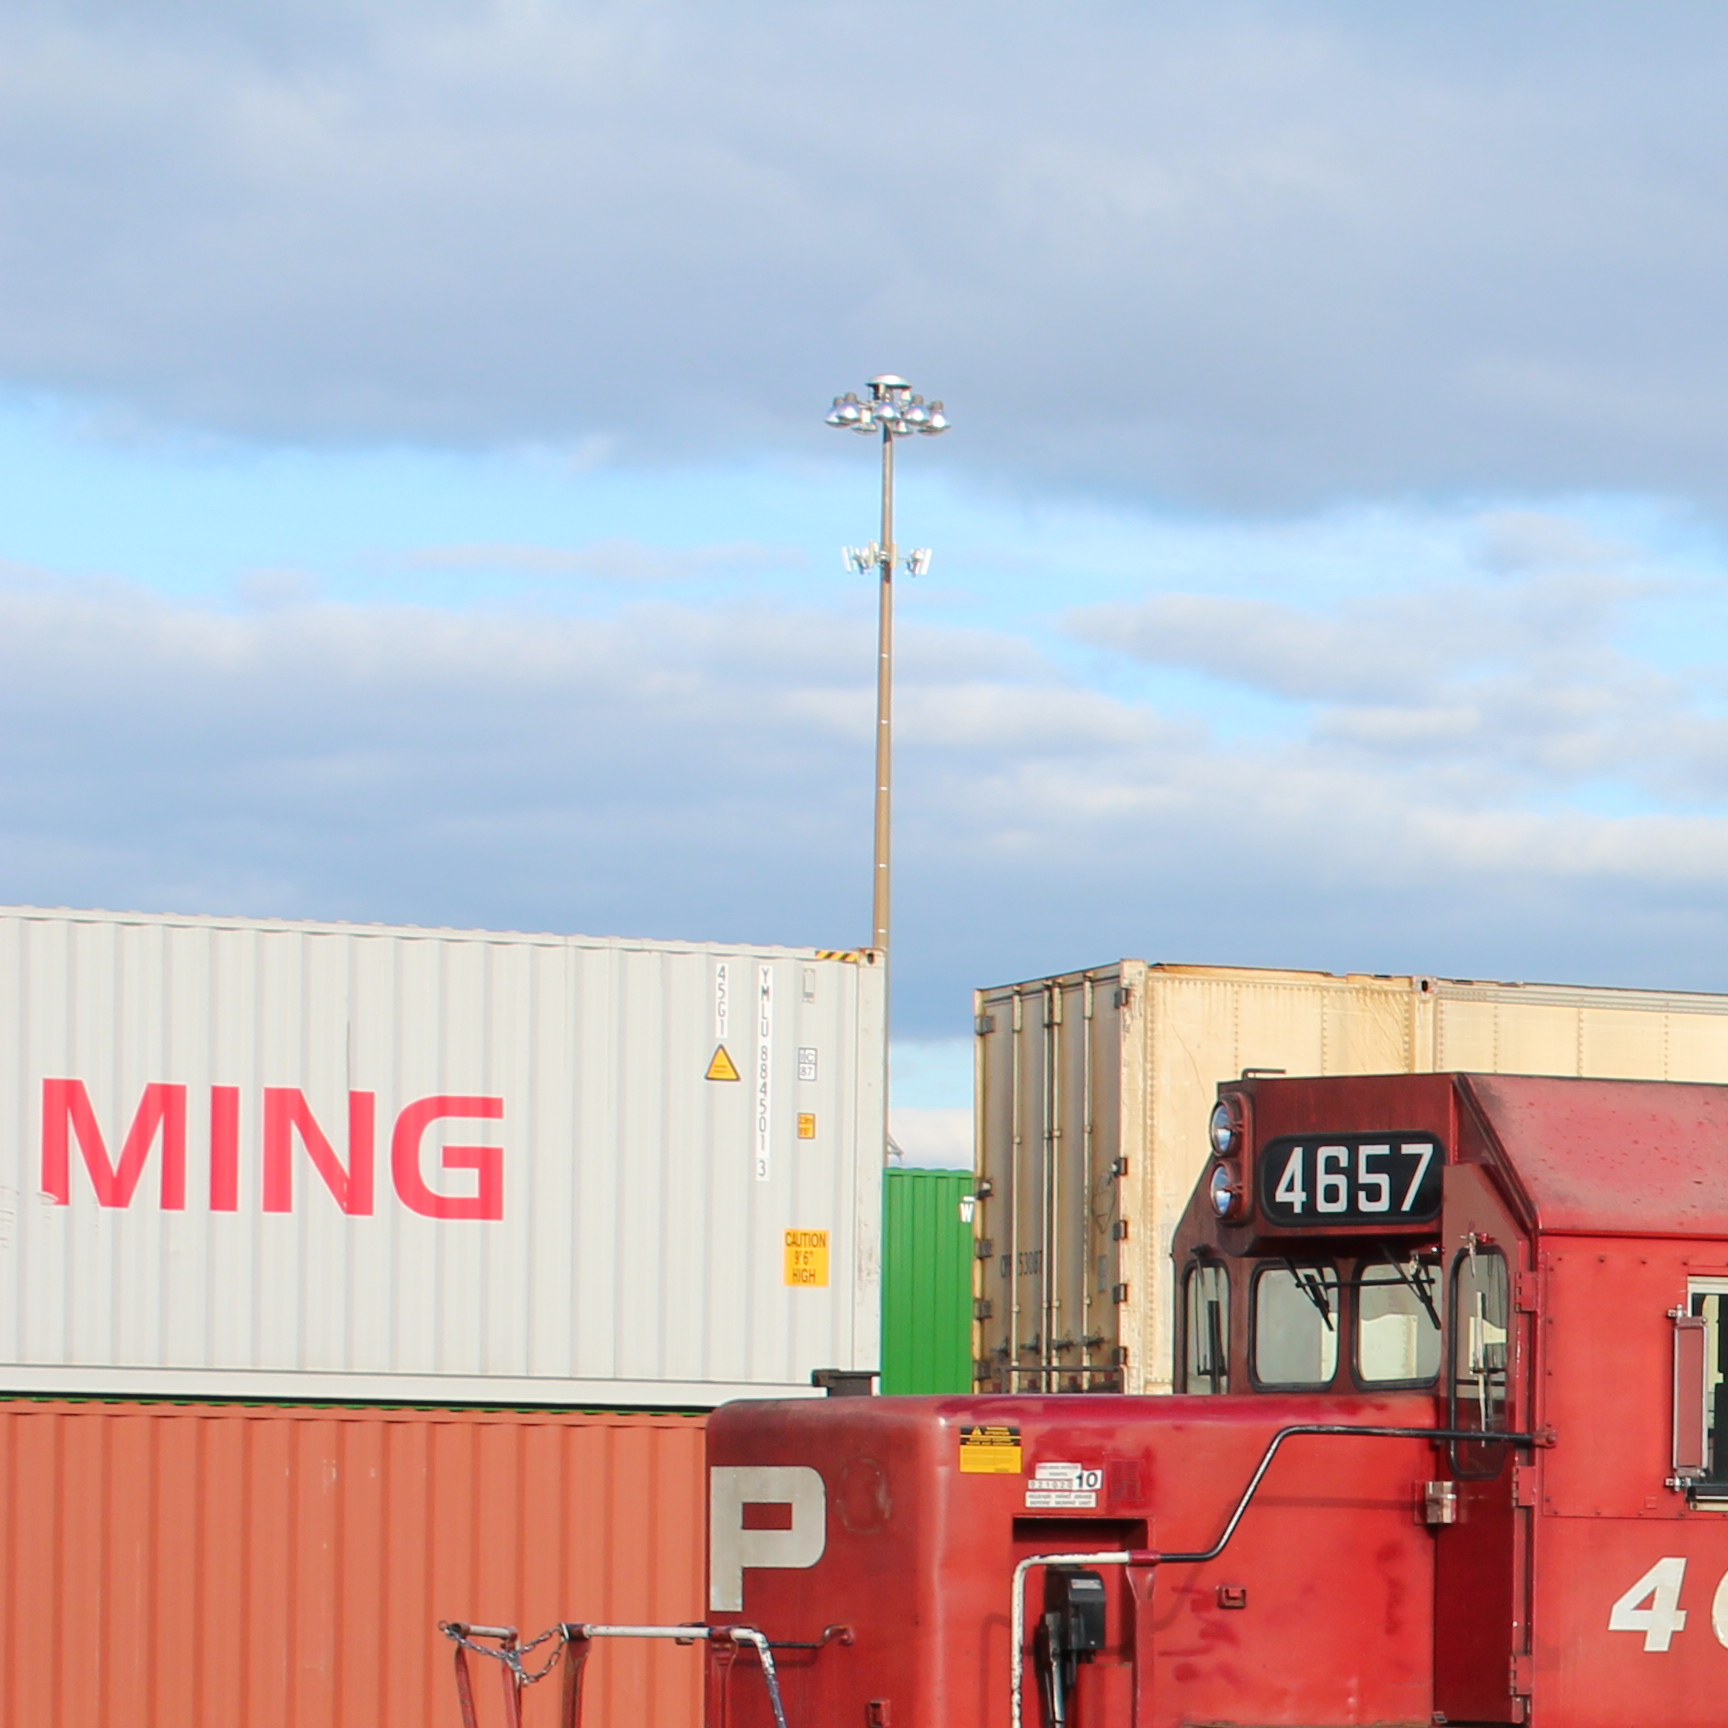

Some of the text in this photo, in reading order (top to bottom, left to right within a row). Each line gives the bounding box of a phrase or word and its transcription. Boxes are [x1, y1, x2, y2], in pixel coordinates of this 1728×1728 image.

[716, 965, 727, 1036] 45G1
[760, 967, 770, 1037] YMLU
[759, 1045, 768, 1151] 884501
[41, 1078, 504, 1221] MING
[1275, 1143, 1434, 1213] 4657
[784, 1231, 827, 1248] CAUTION
[792, 1268, 816, 1283] HIGH
[1075, 1472, 1099, 1488] 10
[710, 1466, 826, 1612] P
